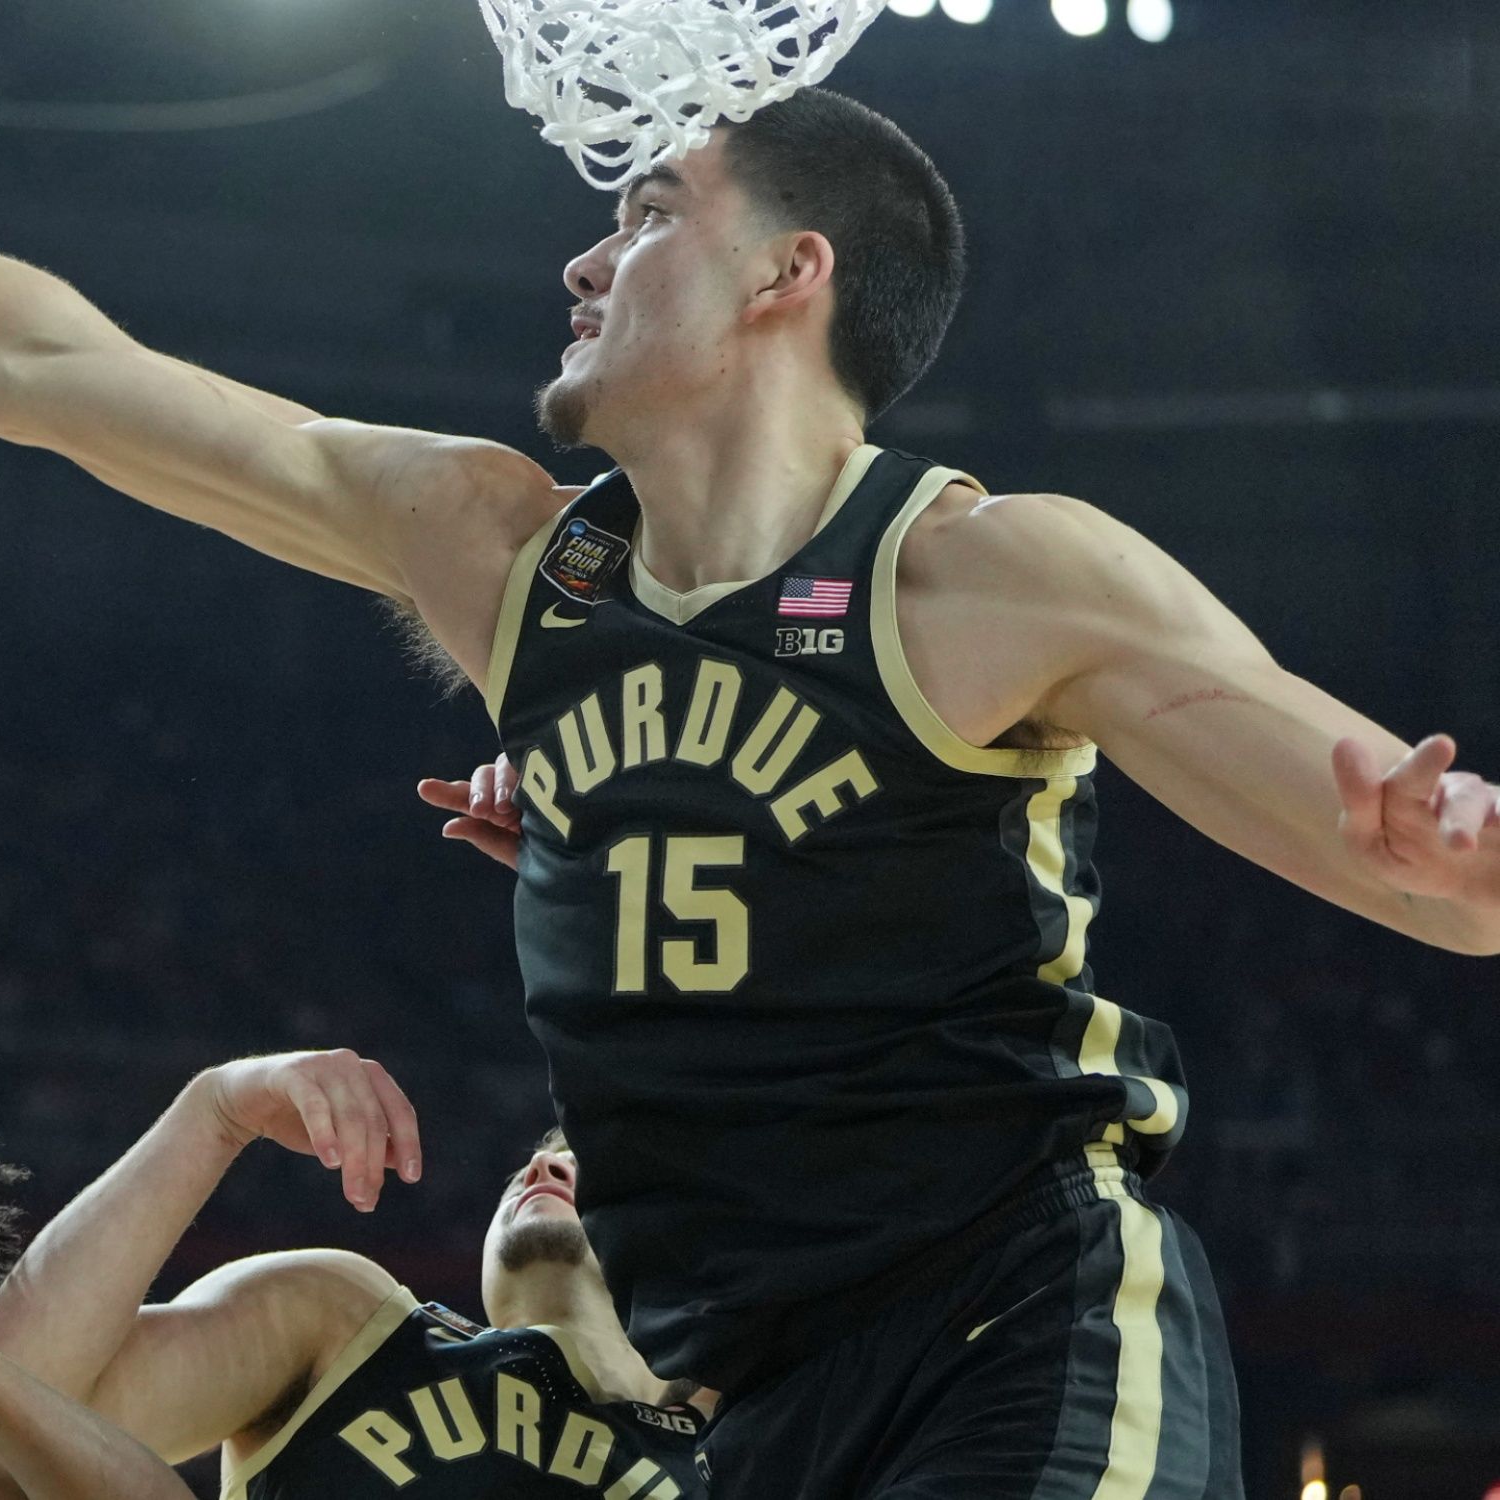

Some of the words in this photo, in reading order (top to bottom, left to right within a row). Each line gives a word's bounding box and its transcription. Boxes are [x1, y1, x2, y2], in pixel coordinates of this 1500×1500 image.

[559, 549, 602, 574] FOUR
[567, 536, 610, 562] FINAL
[519, 657, 882, 846] PURDUE
[604, 833, 751, 994] 15
[334, 1368, 712, 1500] PURDU
